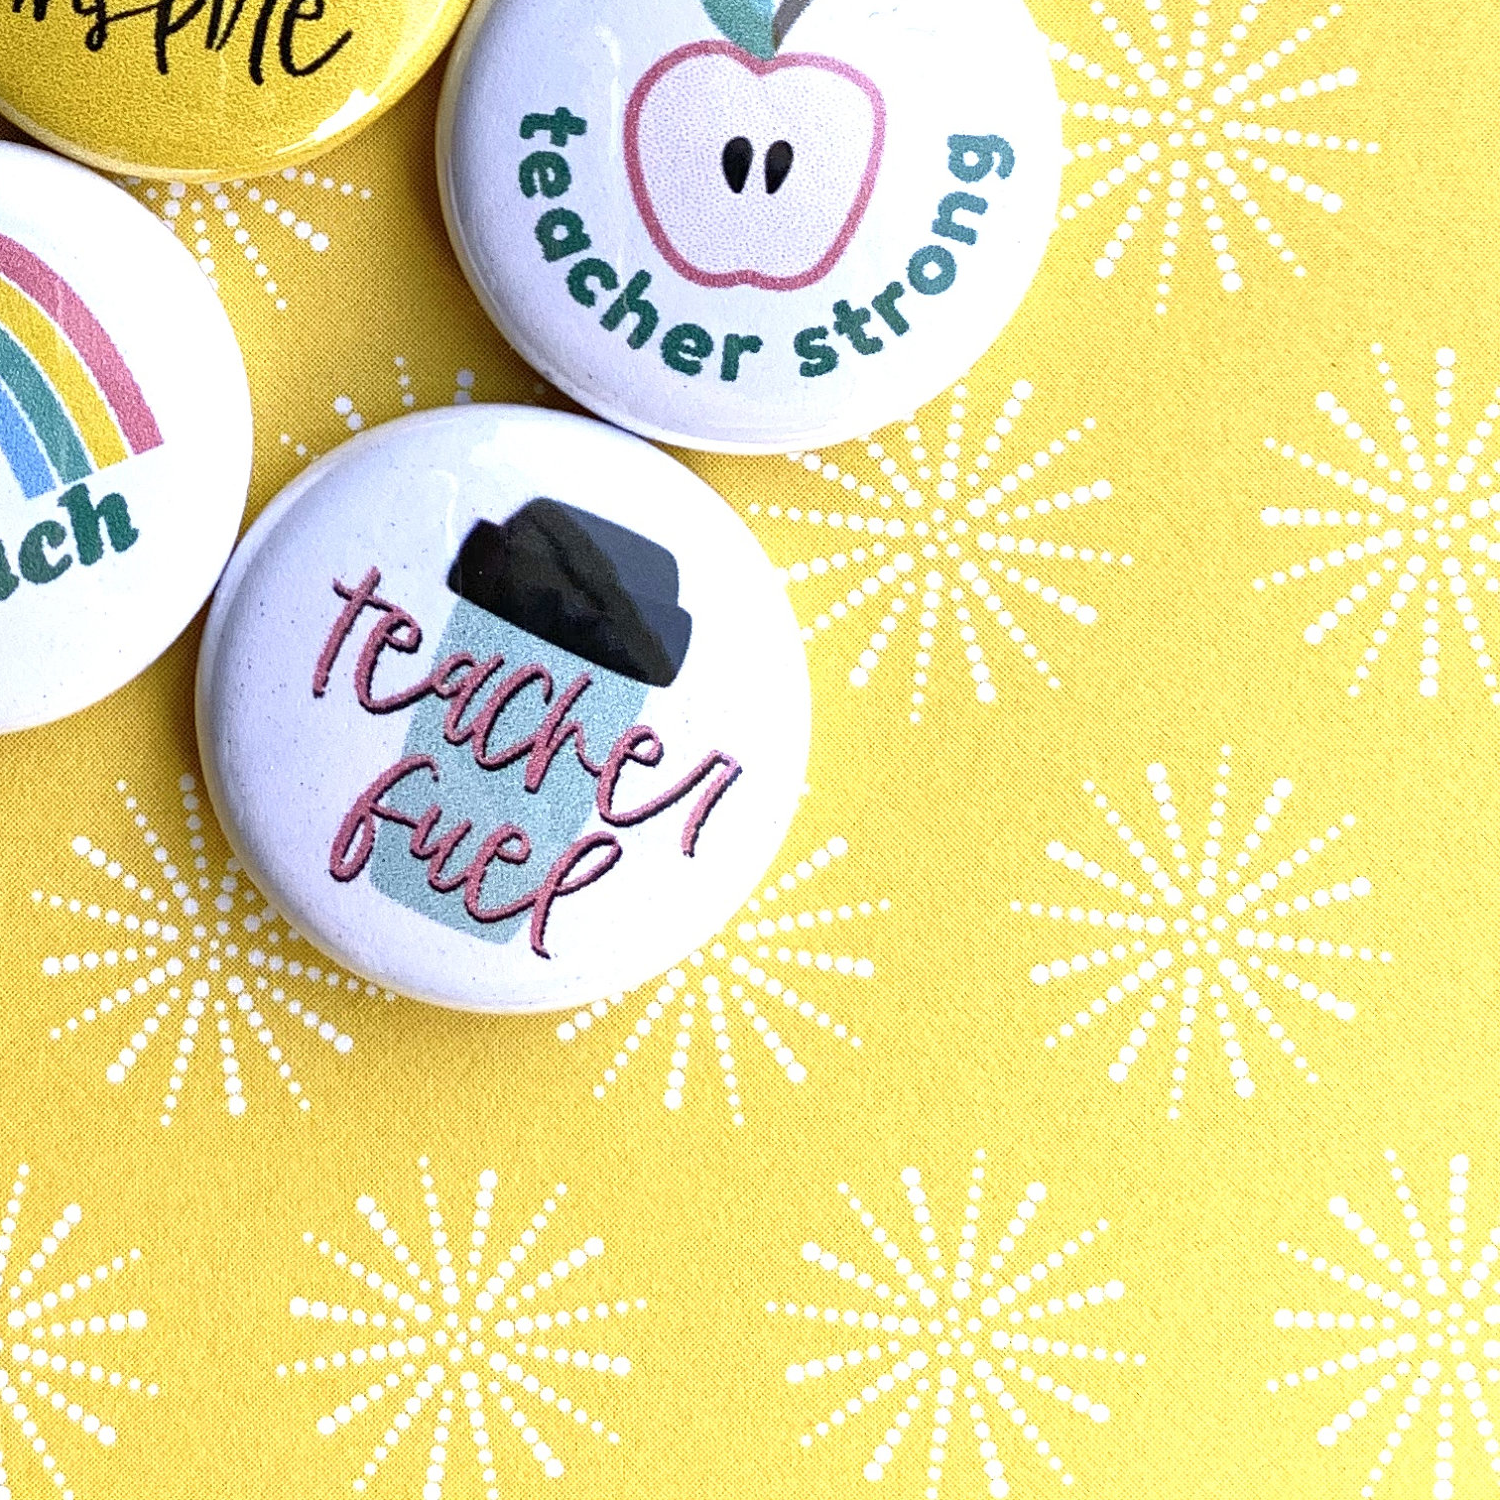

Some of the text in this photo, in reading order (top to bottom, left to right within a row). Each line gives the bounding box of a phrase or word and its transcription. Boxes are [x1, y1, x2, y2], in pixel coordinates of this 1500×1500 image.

[518, 106, 1016, 382] teacher strong
[312, 565, 743, 858] teacher
[329, 753, 622, 960] fuel
